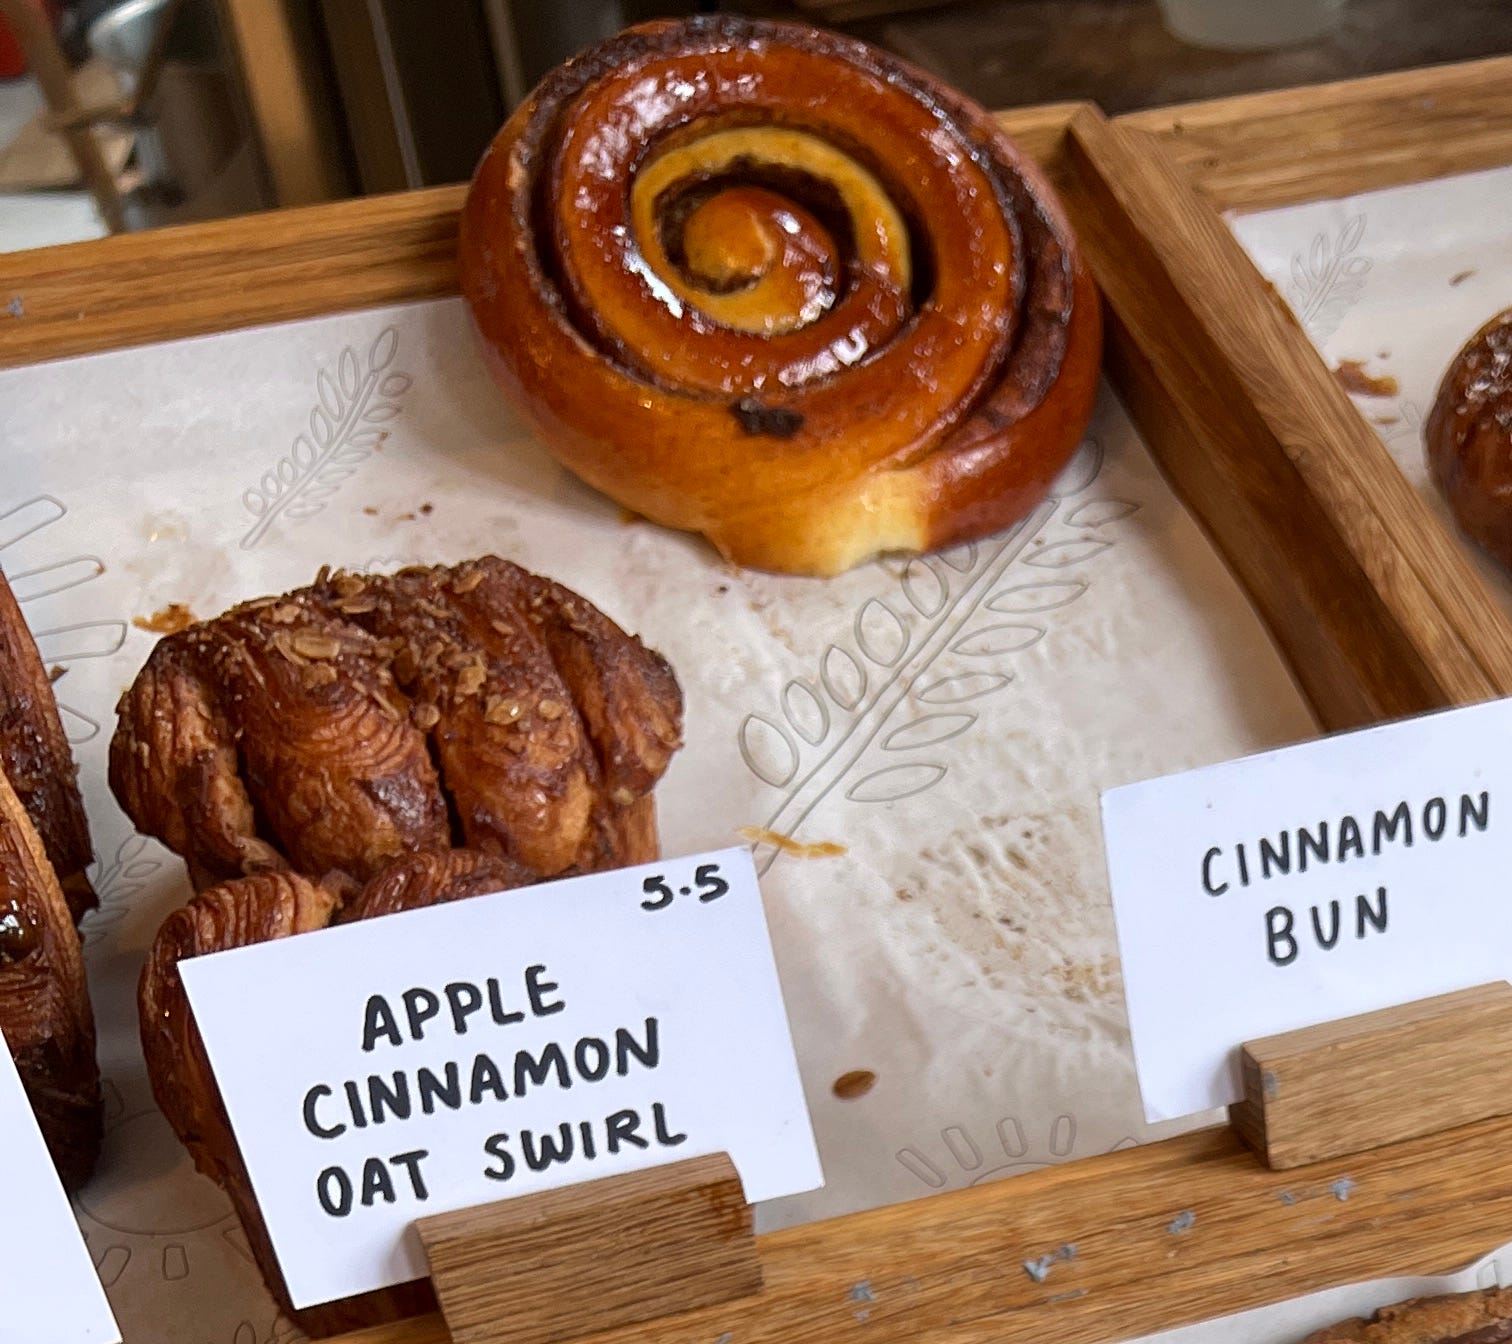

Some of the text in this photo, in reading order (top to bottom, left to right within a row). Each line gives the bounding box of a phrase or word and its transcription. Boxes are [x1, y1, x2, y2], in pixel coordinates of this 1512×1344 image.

[640, 863, 730, 912] 5.5
[1201, 790, 1489, 897] CINNAMON
[1264, 886, 1388, 967] BUN
[361, 964, 566, 1053] APPLE
[302, 1016, 660, 1140] CINNAMON
[316, 1102, 688, 1218] OAT SWIRL
